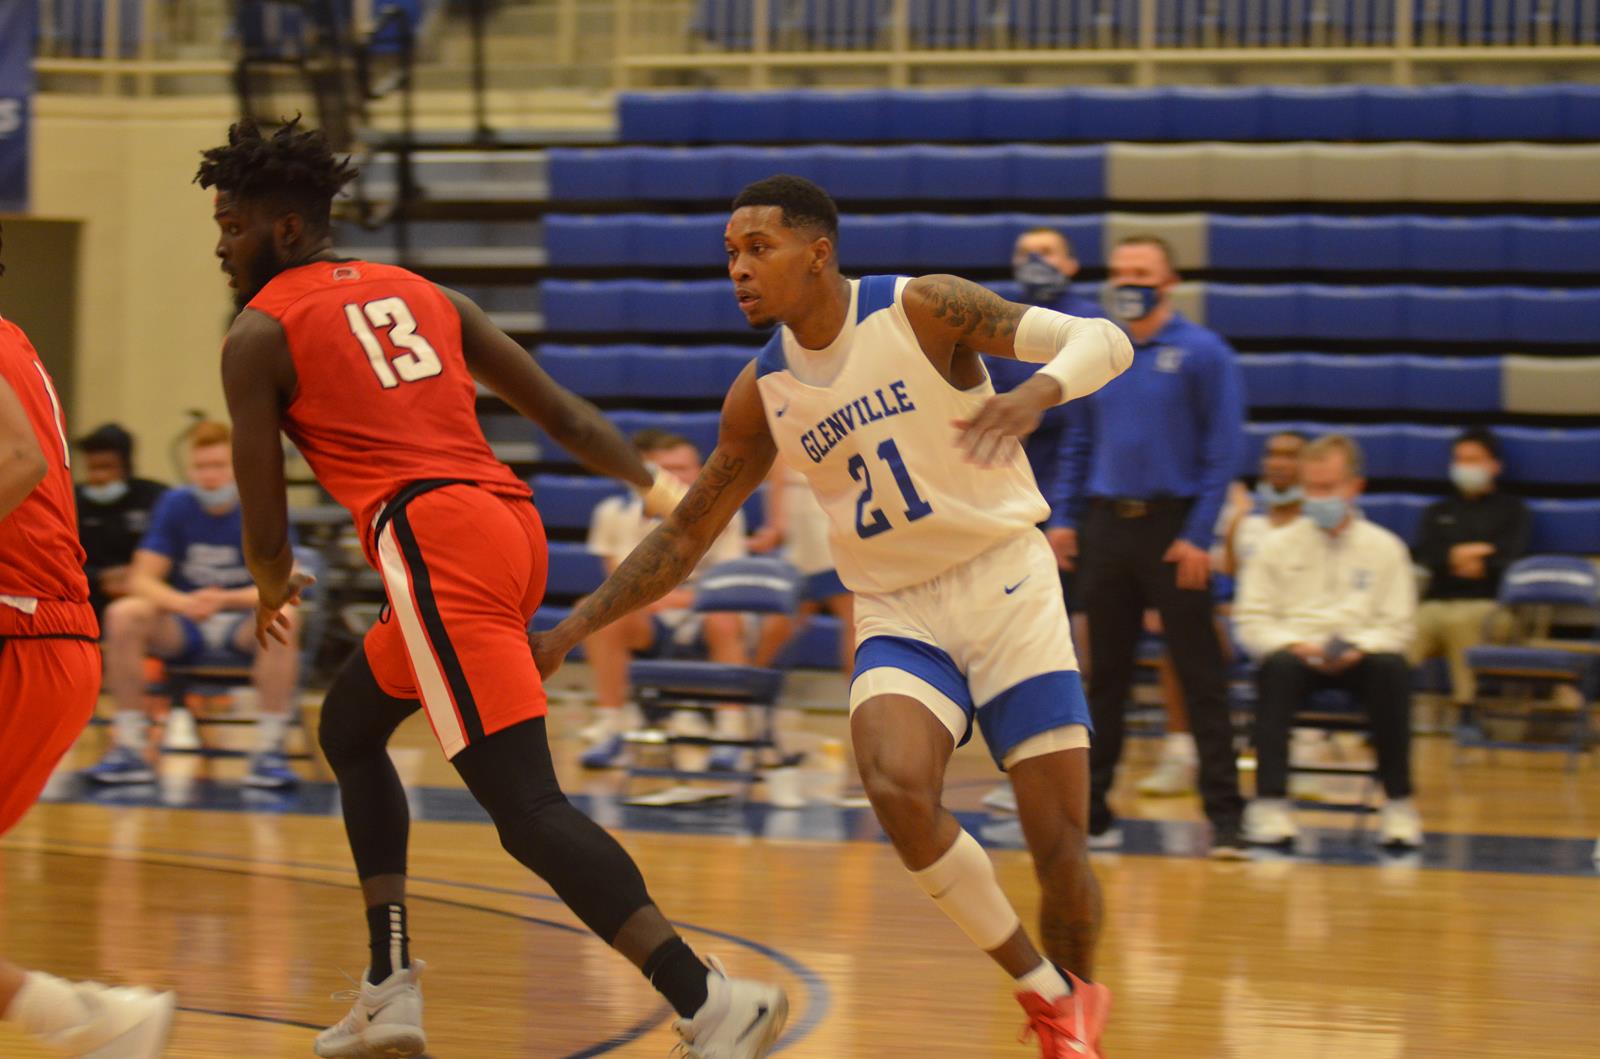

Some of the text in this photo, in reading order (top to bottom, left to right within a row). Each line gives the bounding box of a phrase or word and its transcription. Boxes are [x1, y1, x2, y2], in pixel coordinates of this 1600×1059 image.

[344, 296, 443, 390] 13
[800, 380, 916, 464] GLENVILLE
[847, 437, 934, 539] 21
